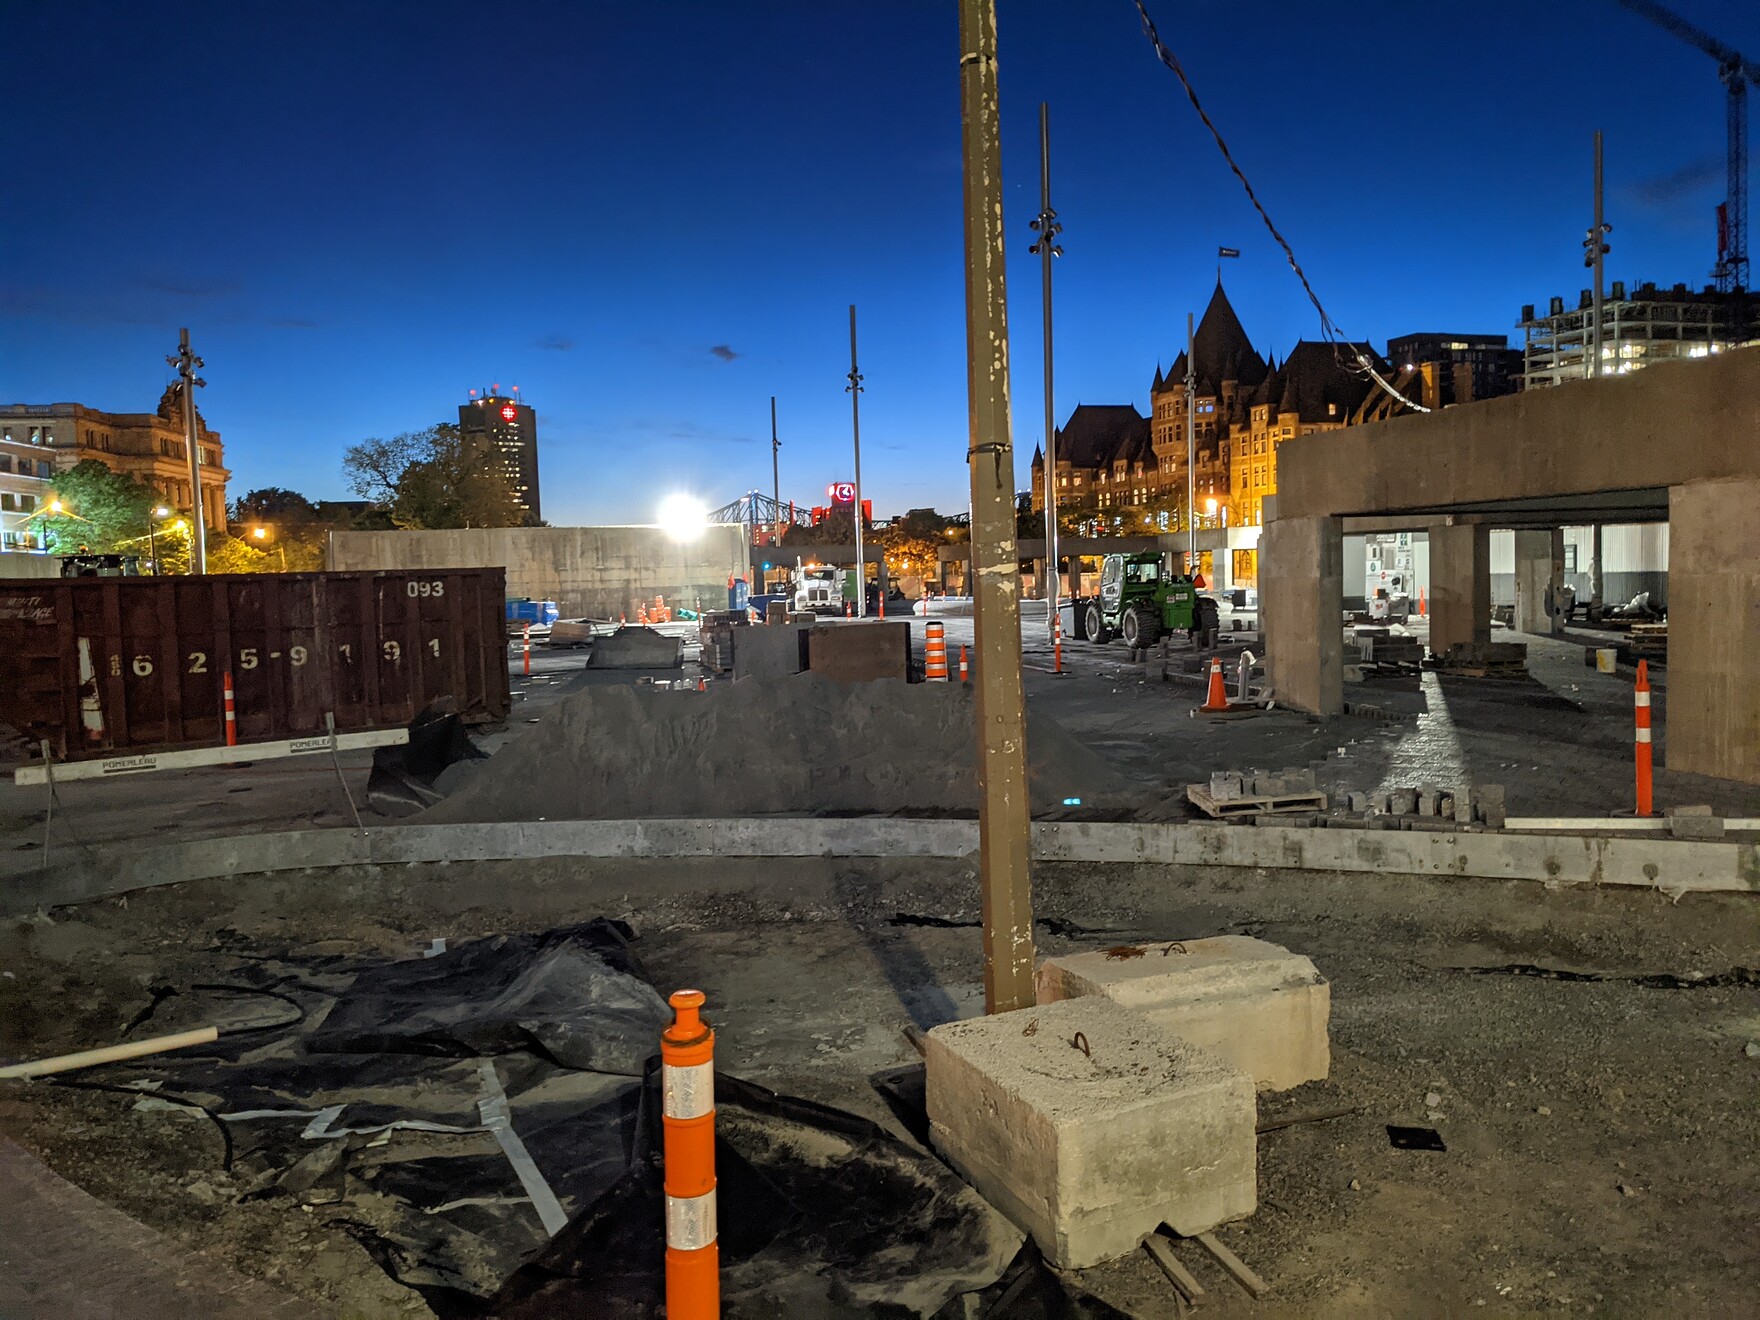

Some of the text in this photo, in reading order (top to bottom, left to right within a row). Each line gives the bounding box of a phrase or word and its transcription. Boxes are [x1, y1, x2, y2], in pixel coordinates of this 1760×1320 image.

[407, 581, 444, 597] 093
[289, 738, 331, 748] POMERLE
[102, 757, 157, 768] POMERLEAU
